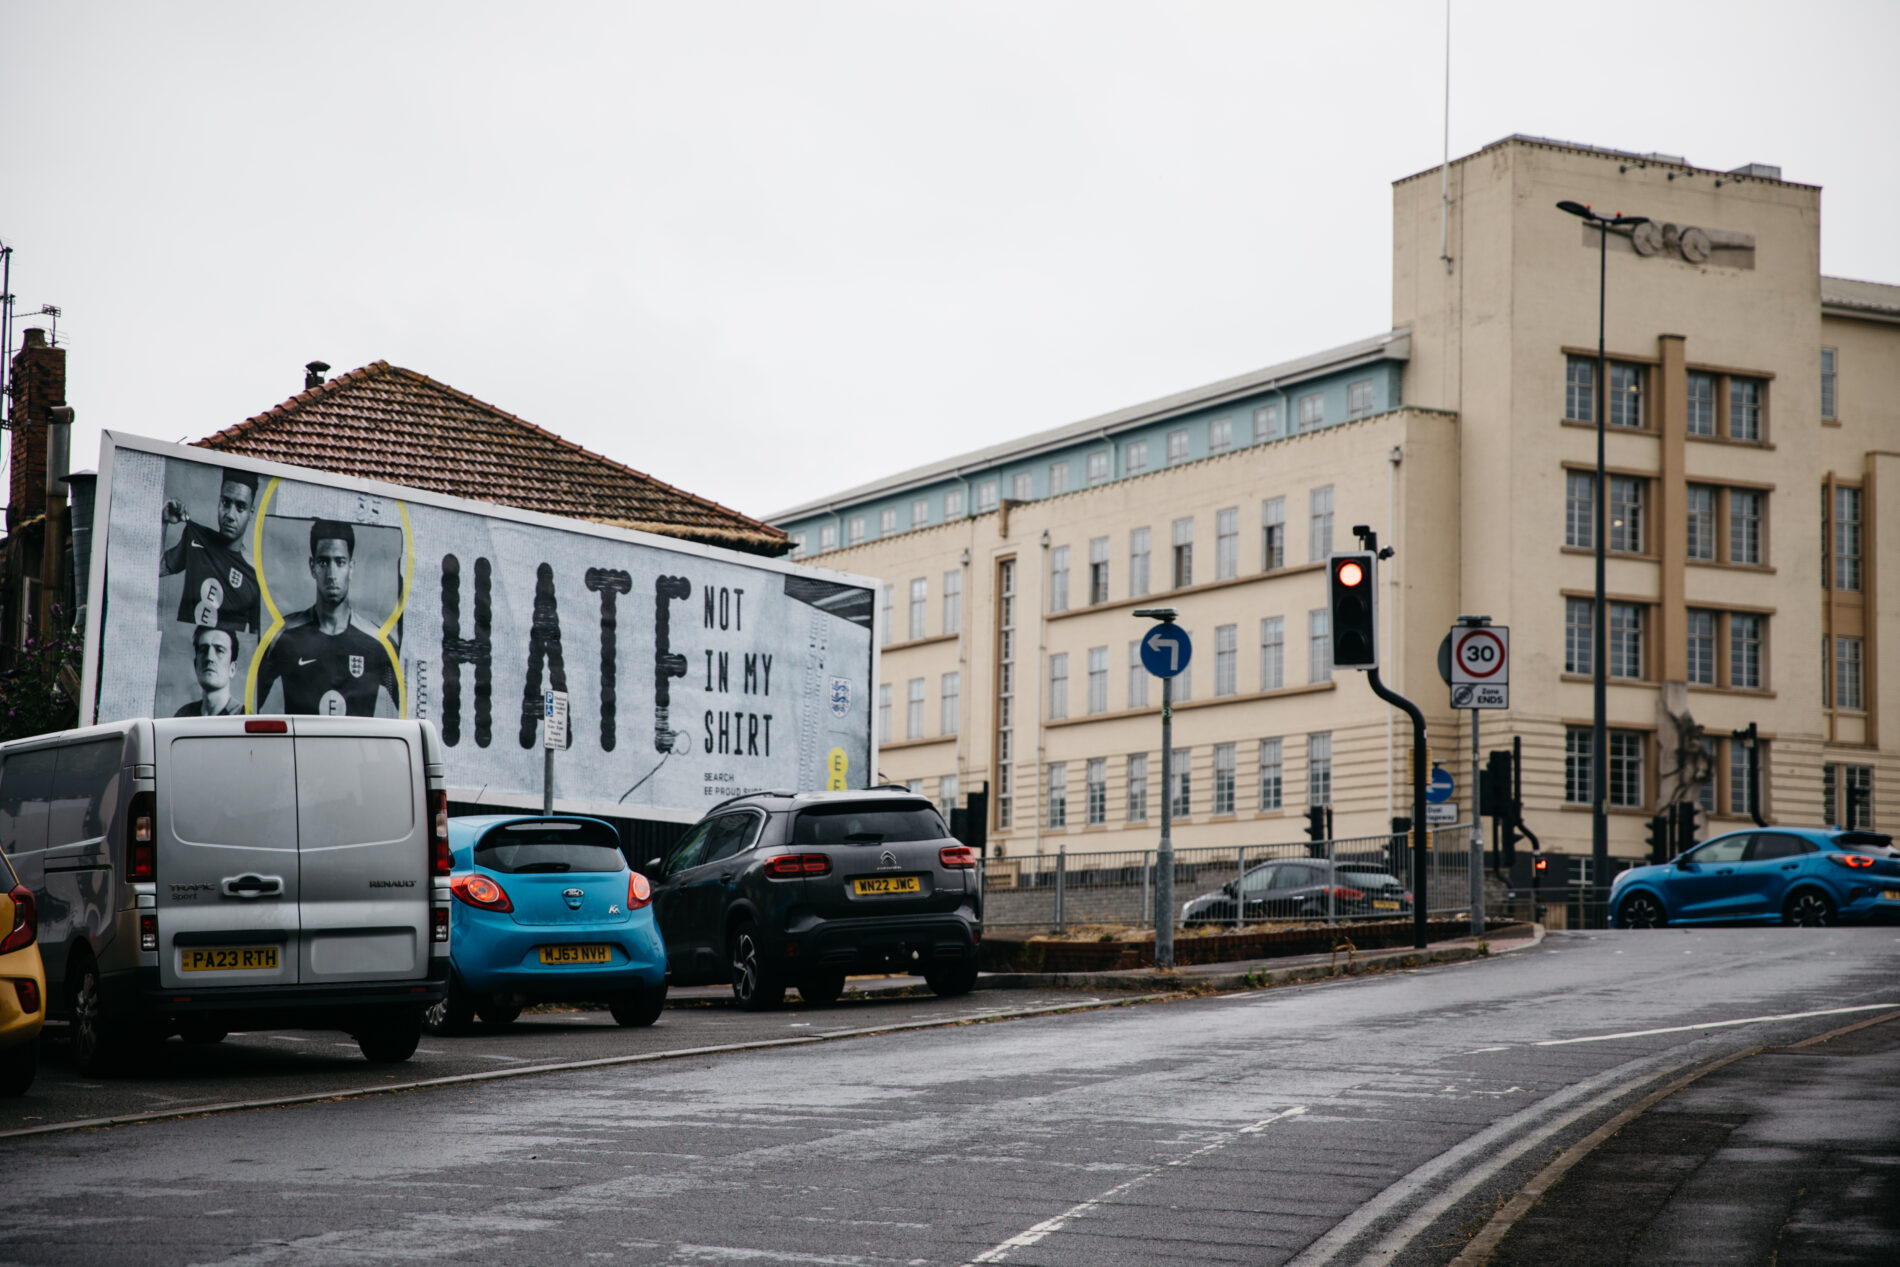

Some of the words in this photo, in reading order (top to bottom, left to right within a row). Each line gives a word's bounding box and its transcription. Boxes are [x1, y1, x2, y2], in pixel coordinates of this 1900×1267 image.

[704, 585, 744, 631] NOT
[441, 553, 692, 754] HATE
[1467, 645, 1495, 662] 30
[705, 649, 728, 693] IN
[744, 652, 773, 696] MY
[1477, 695, 1503, 704] ENDS
[704, 709, 773, 757] SHIRT
[704, 772, 735, 782] SEARCH
[704, 786, 713, 796] EE
[715, 786, 741, 797] PROUD
[368, 879, 416, 888] RENAULT
[860, 879, 889, 892] WN22
[893, 878, 915, 890] JWC
[172, 892, 197, 900] Sport
[193, 951, 238, 968] PA23
[243, 949, 276, 966] RTH
[545, 947, 578, 961] MJ63
[581, 946, 606, 959] NVH
